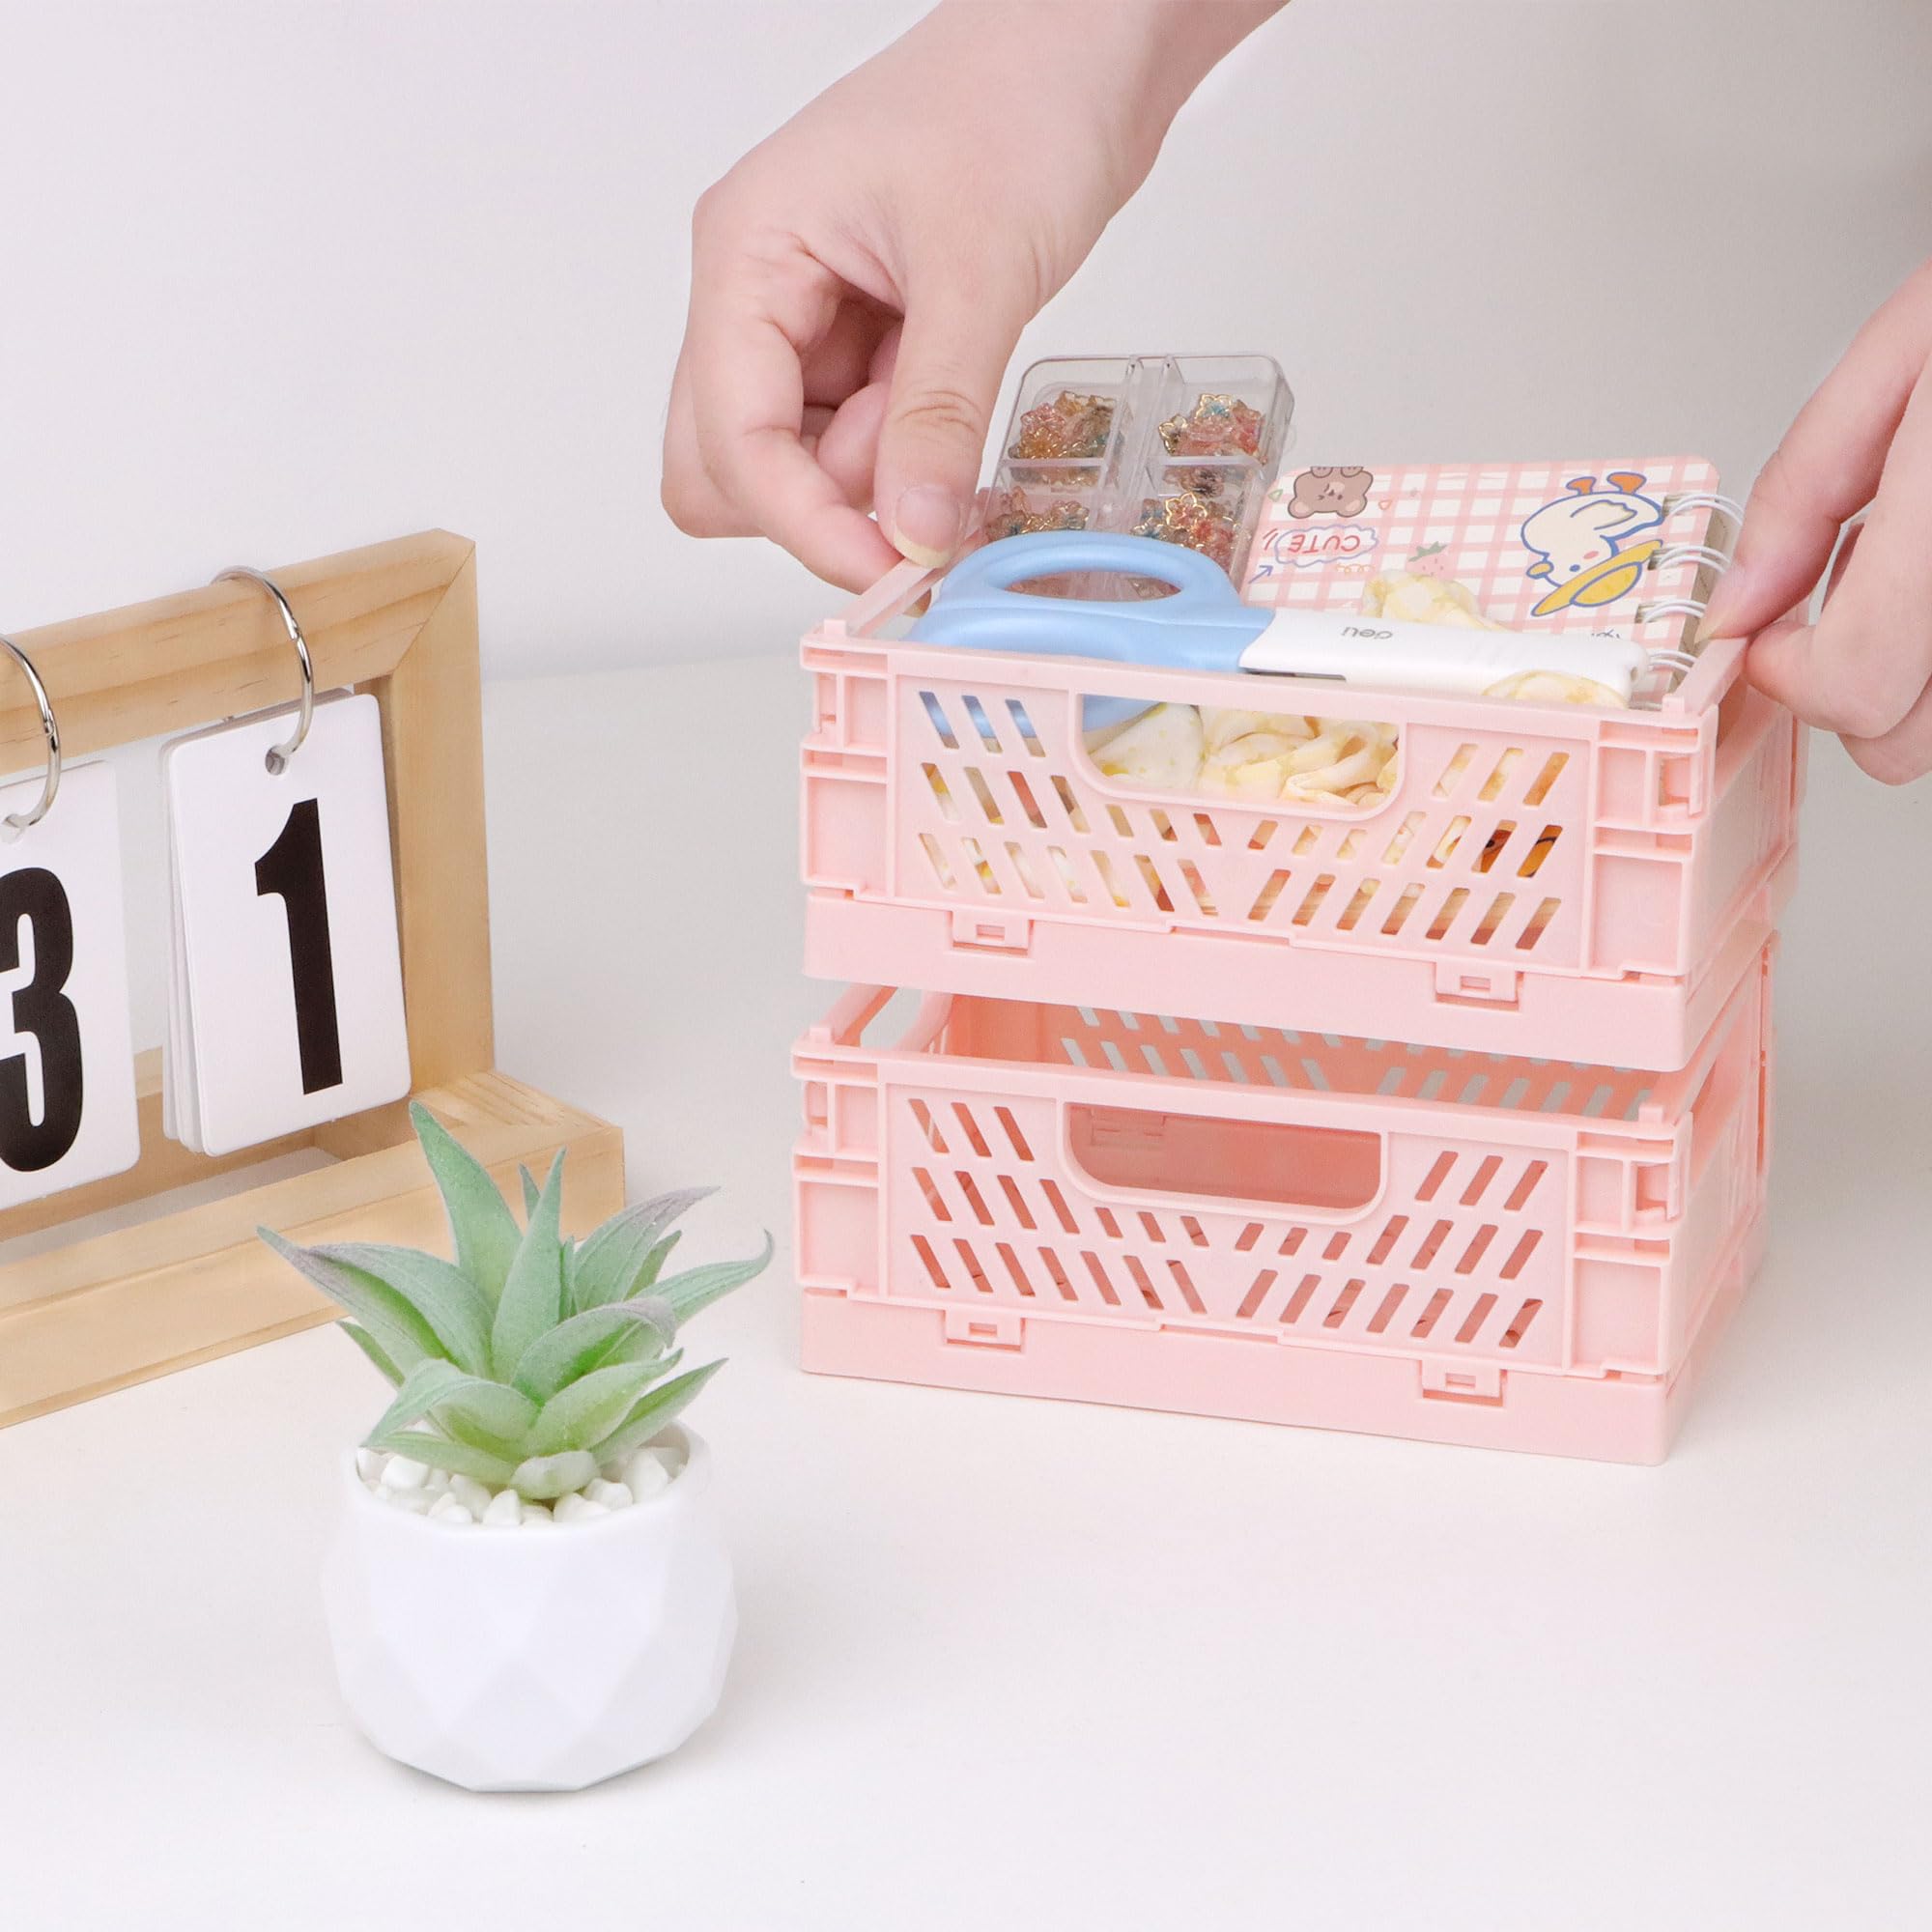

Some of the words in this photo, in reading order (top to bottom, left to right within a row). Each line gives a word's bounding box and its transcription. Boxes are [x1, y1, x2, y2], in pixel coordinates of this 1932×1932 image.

[1288, 533, 1361, 554] CUTE
[1341, 626, 1393, 639] deli
[0, 867, 83, 1173] 3
[254, 798, 343, 1095] 1
